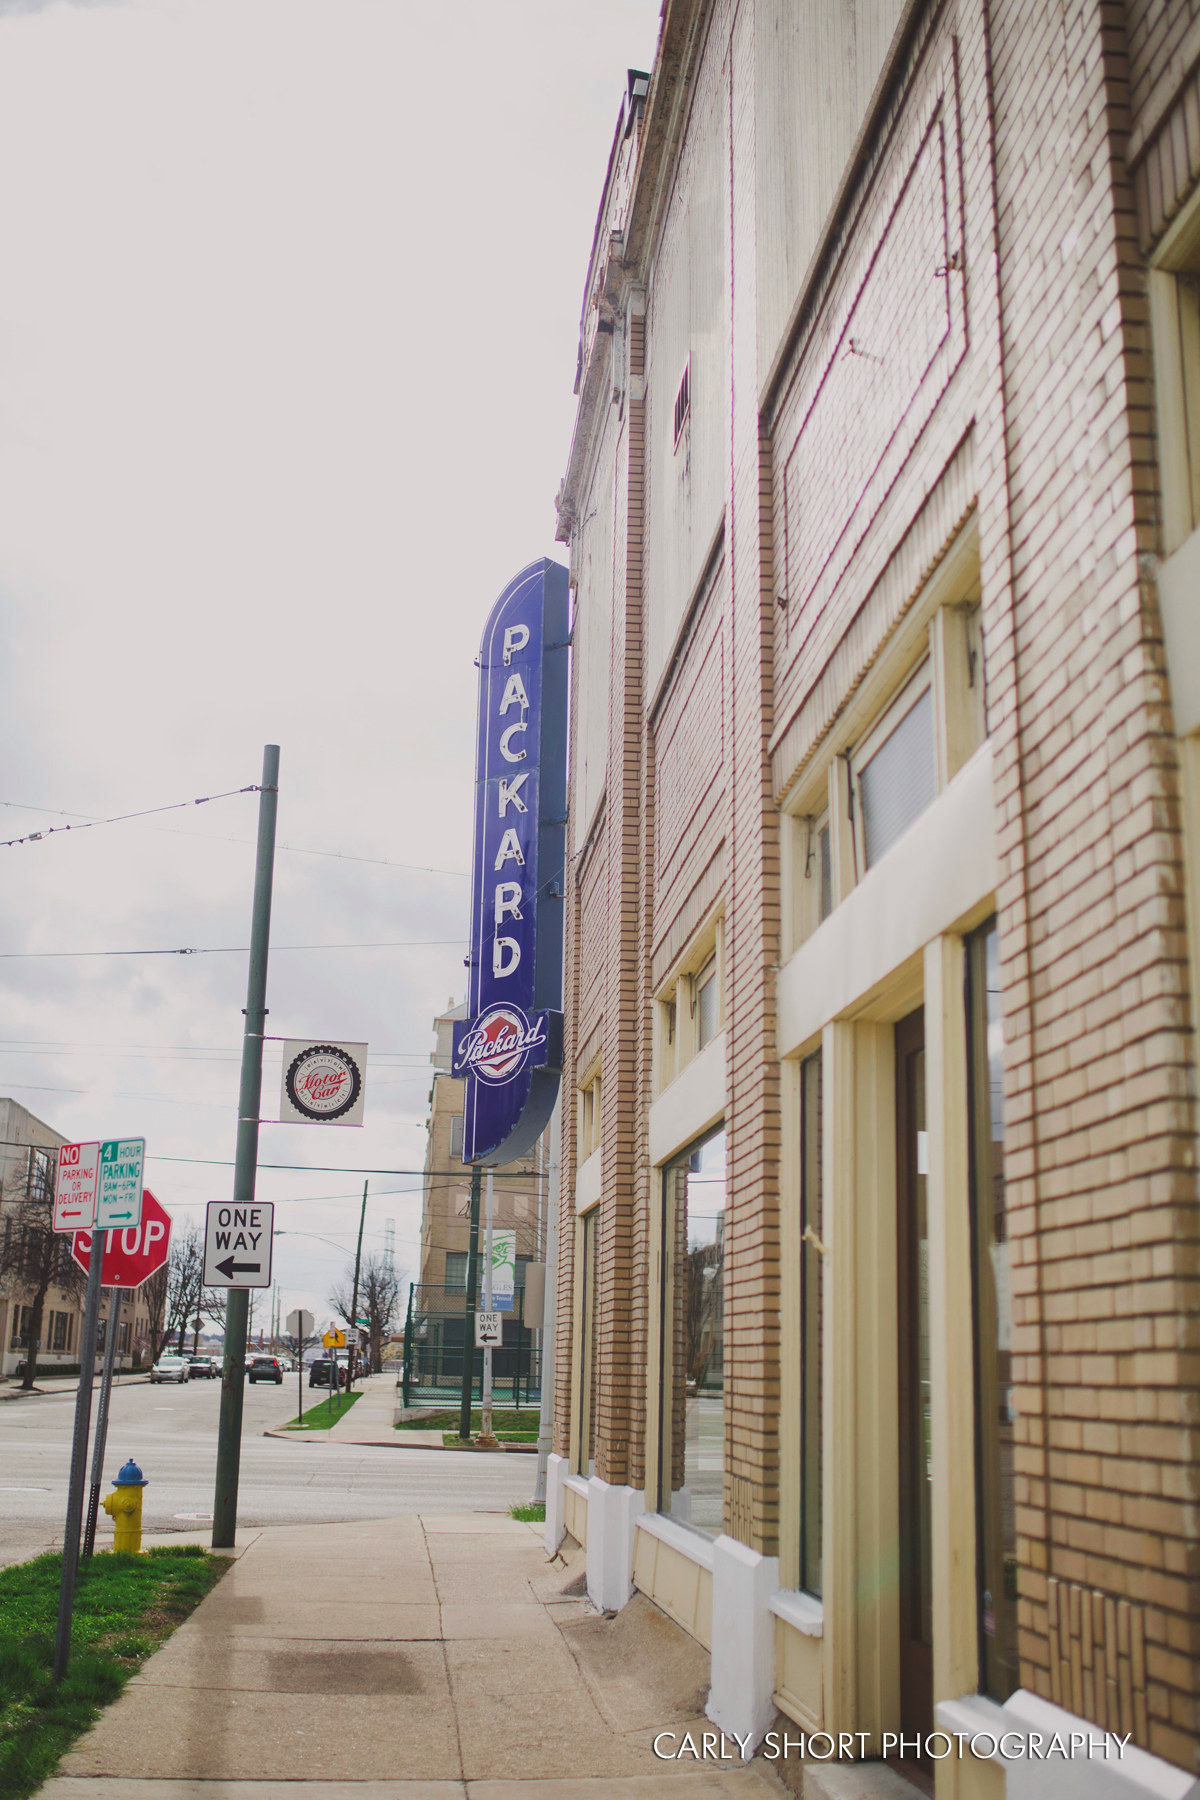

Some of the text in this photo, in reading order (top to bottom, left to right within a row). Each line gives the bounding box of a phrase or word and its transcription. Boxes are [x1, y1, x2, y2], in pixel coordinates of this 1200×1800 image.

[492, 623, 530, 979] PACKARD
[454, 1015, 546, 1070] Packard
[295, 1070, 347, 1093] Motor
[311, 1085, 340, 1100] Car
[60, 1146, 79, 1165] NO
[103, 1144, 142, 1161] 4 HOUR
[62, 1167, 94, 1181] PARKING
[103, 1161, 141, 1180] PARKING
[71, 1181, 82, 1192] OR
[58, 1191, 94, 1205] DELIVERY
[217, 1208, 262, 1228] ONE
[215, 1231, 263, 1251] WAY
[479, 1313, 498, 1323] ONE
[479, 1323, 498, 1332] WAY
